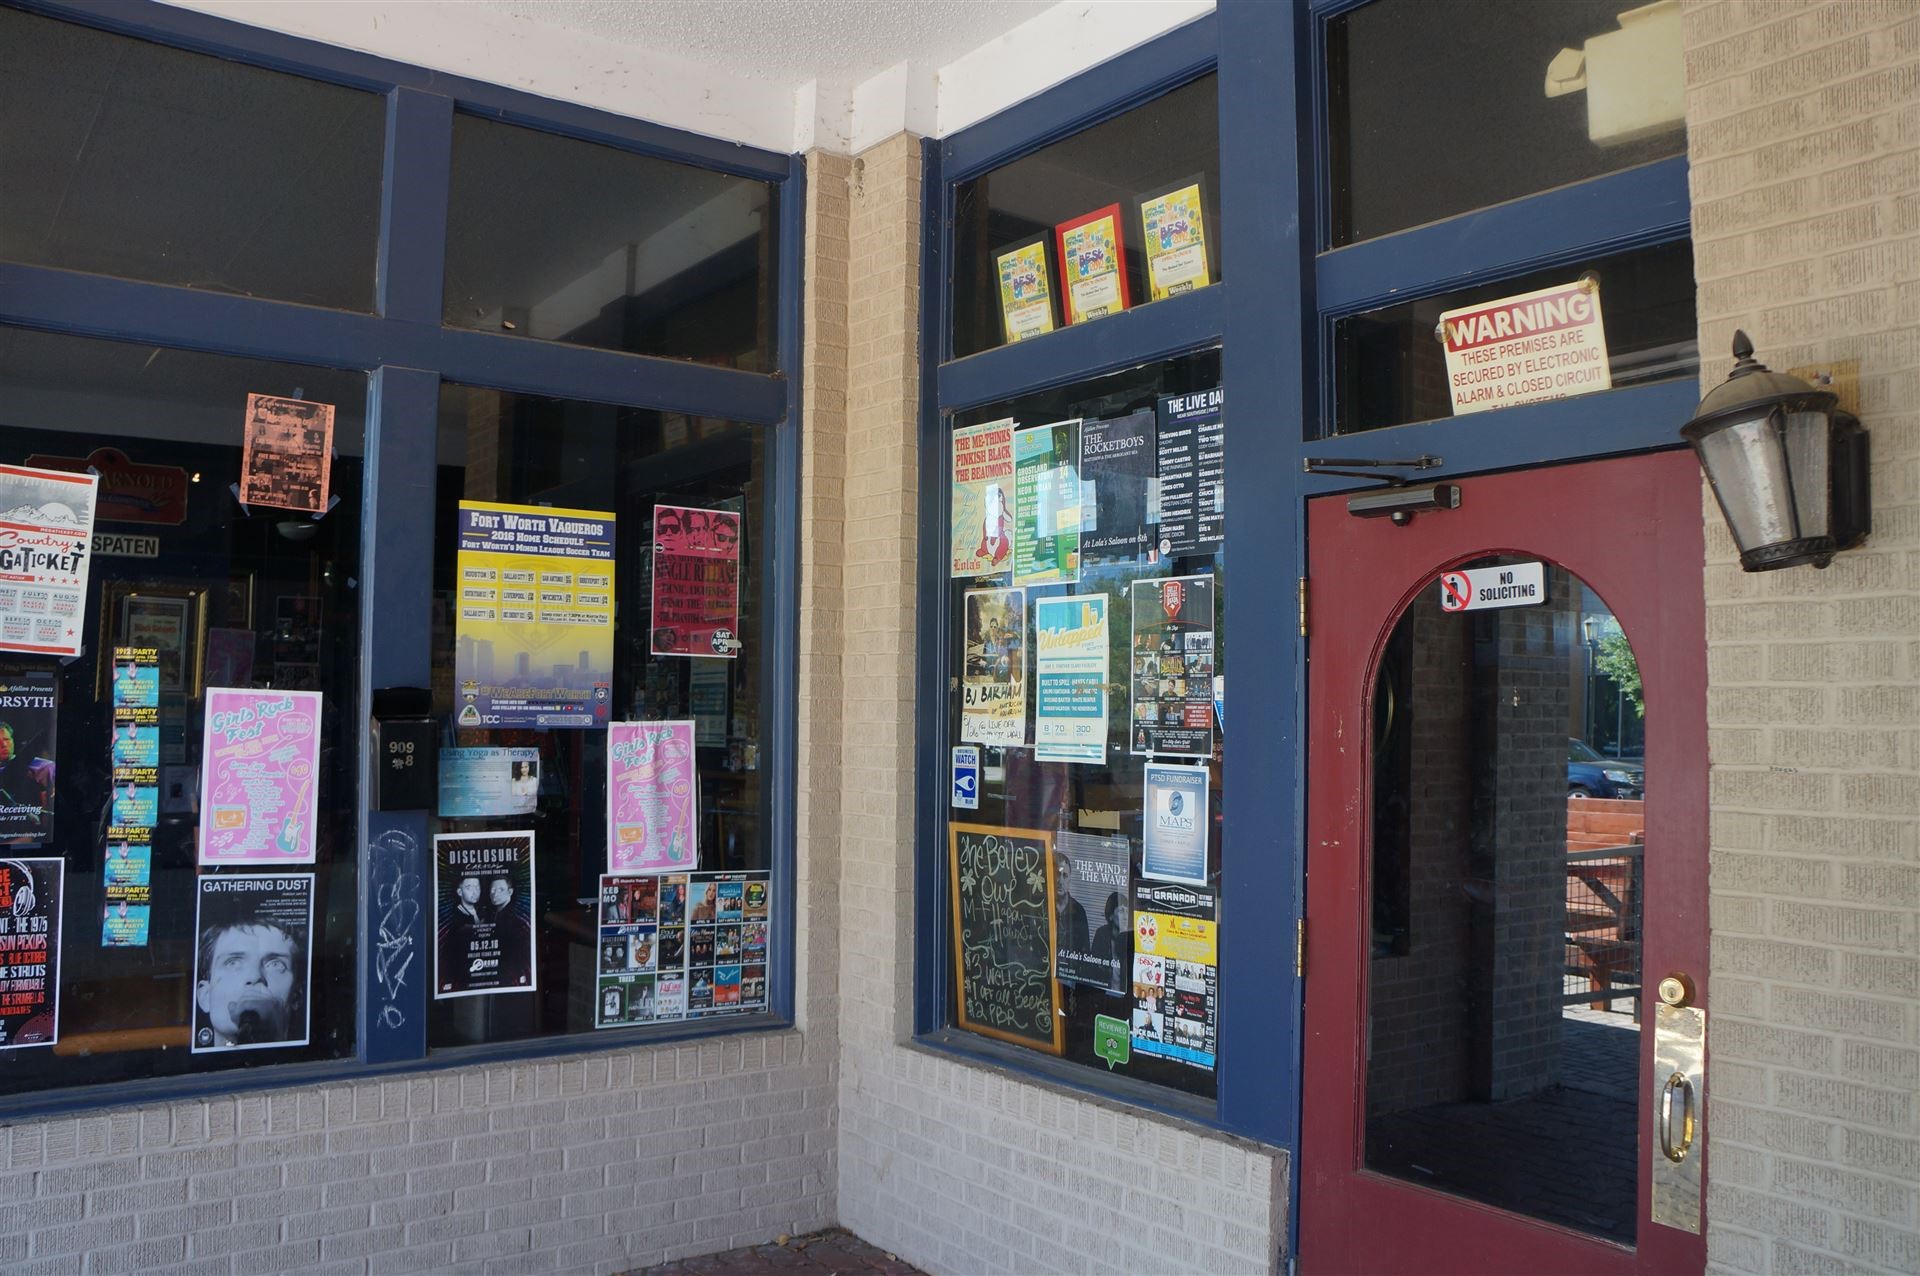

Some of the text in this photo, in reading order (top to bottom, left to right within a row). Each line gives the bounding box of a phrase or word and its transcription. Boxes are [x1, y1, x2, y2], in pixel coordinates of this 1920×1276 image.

[1168, 283, 1192, 294] Weekly
[1087, 308, 1108, 318] Weekly
[1451, 293, 1590, 347] WARNING
[1462, 330, 1584, 366] THESE PREMISES ARE
[1454, 348, 1600, 386] SECURED BY ELECTRONIC
[1456, 387, 1494, 406] ALARM
[1497, 384, 1504, 398] &
[1508, 376, 1552, 396] CLOSED
[1556, 367, 1602, 386] CIRCUIT
[1168, 398, 1184, 414] THE
[1186, 394, 1206, 410] LIVE
[956, 437, 970, 452] THE
[972, 428, 1010, 448] ME-THINKS
[1084, 433, 1102, 444] THE
[1084, 436, 1144, 455] ROCKETBOYS
[956, 445, 1010, 466] PINKISH BLACK
[1175, 456, 1191, 464] CASTRO
[956, 461, 1012, 482] THE BEAUMONTS
[1018, 464, 1048, 476] GHOSTLAND
[471, 512, 603, 536] FORT WORTH VAQUEROS
[0, 531, 72, 554] Country
[92, 536, 156, 555] SPATEN
[492, 531, 584, 546] 2016 HOME SCHEDULE
[1083, 540, 1090, 548] At
[1092, 538, 1108, 548] Lola's
[1108, 536, 1128, 546] Saloon
[1137, 534, 1148, 542] 6th
[462, 540, 610, 557] FORT WORTH'S MINOR LEAGUE SOCCER TEAM
[1500, 572, 1513, 584] NO
[1480, 584, 1534, 601] SOLICITING
[1040, 624, 1104, 650] Untapped
[966, 688, 977, 706] BJ
[980, 684, 1022, 702] BARHAM
[213, 708, 254, 734] Girls
[257, 697, 294, 718] Rock
[482, 715, 500, 724] TCC
[226, 722, 264, 744] Fest
[389, 741, 415, 754] 909
[612, 727, 673, 760] Girls Rock
[468, 750, 488, 758] Yoga
[503, 750, 535, 758] Therapy
[624, 749, 654, 768] Fest
[956, 754, 976, 764] WATCH
[1166, 774, 1202, 784] FUNDRAISER
[1160, 816, 1192, 828] MAPS
[450, 848, 518, 864] DISCLOSURE
[1075, 860, 1094, 870] THE
[1095, 862, 1120, 874] WIND
[203, 880, 308, 892] GATHERING DUST
[1080, 870, 1127, 886] THE WAVE
[603, 886, 619, 894] KEB
[1154, 891, 1196, 904] GRANADA
[16, 916, 48, 932] THE 1975
[470, 940, 498, 950] 05.12.16
[1058, 949, 1066, 957] At
[1066, 950, 1082, 960] Lola's
[1083, 954, 1102, 964] Saloon
[1110, 959, 1120, 968] 6th
[10, 964, 46, 978] STRUTS
[990, 1004, 1028, 1028] PBR
[1099, 1022, 1126, 1033] REVIEWED
[1177, 1036, 1190, 1045] NADA
